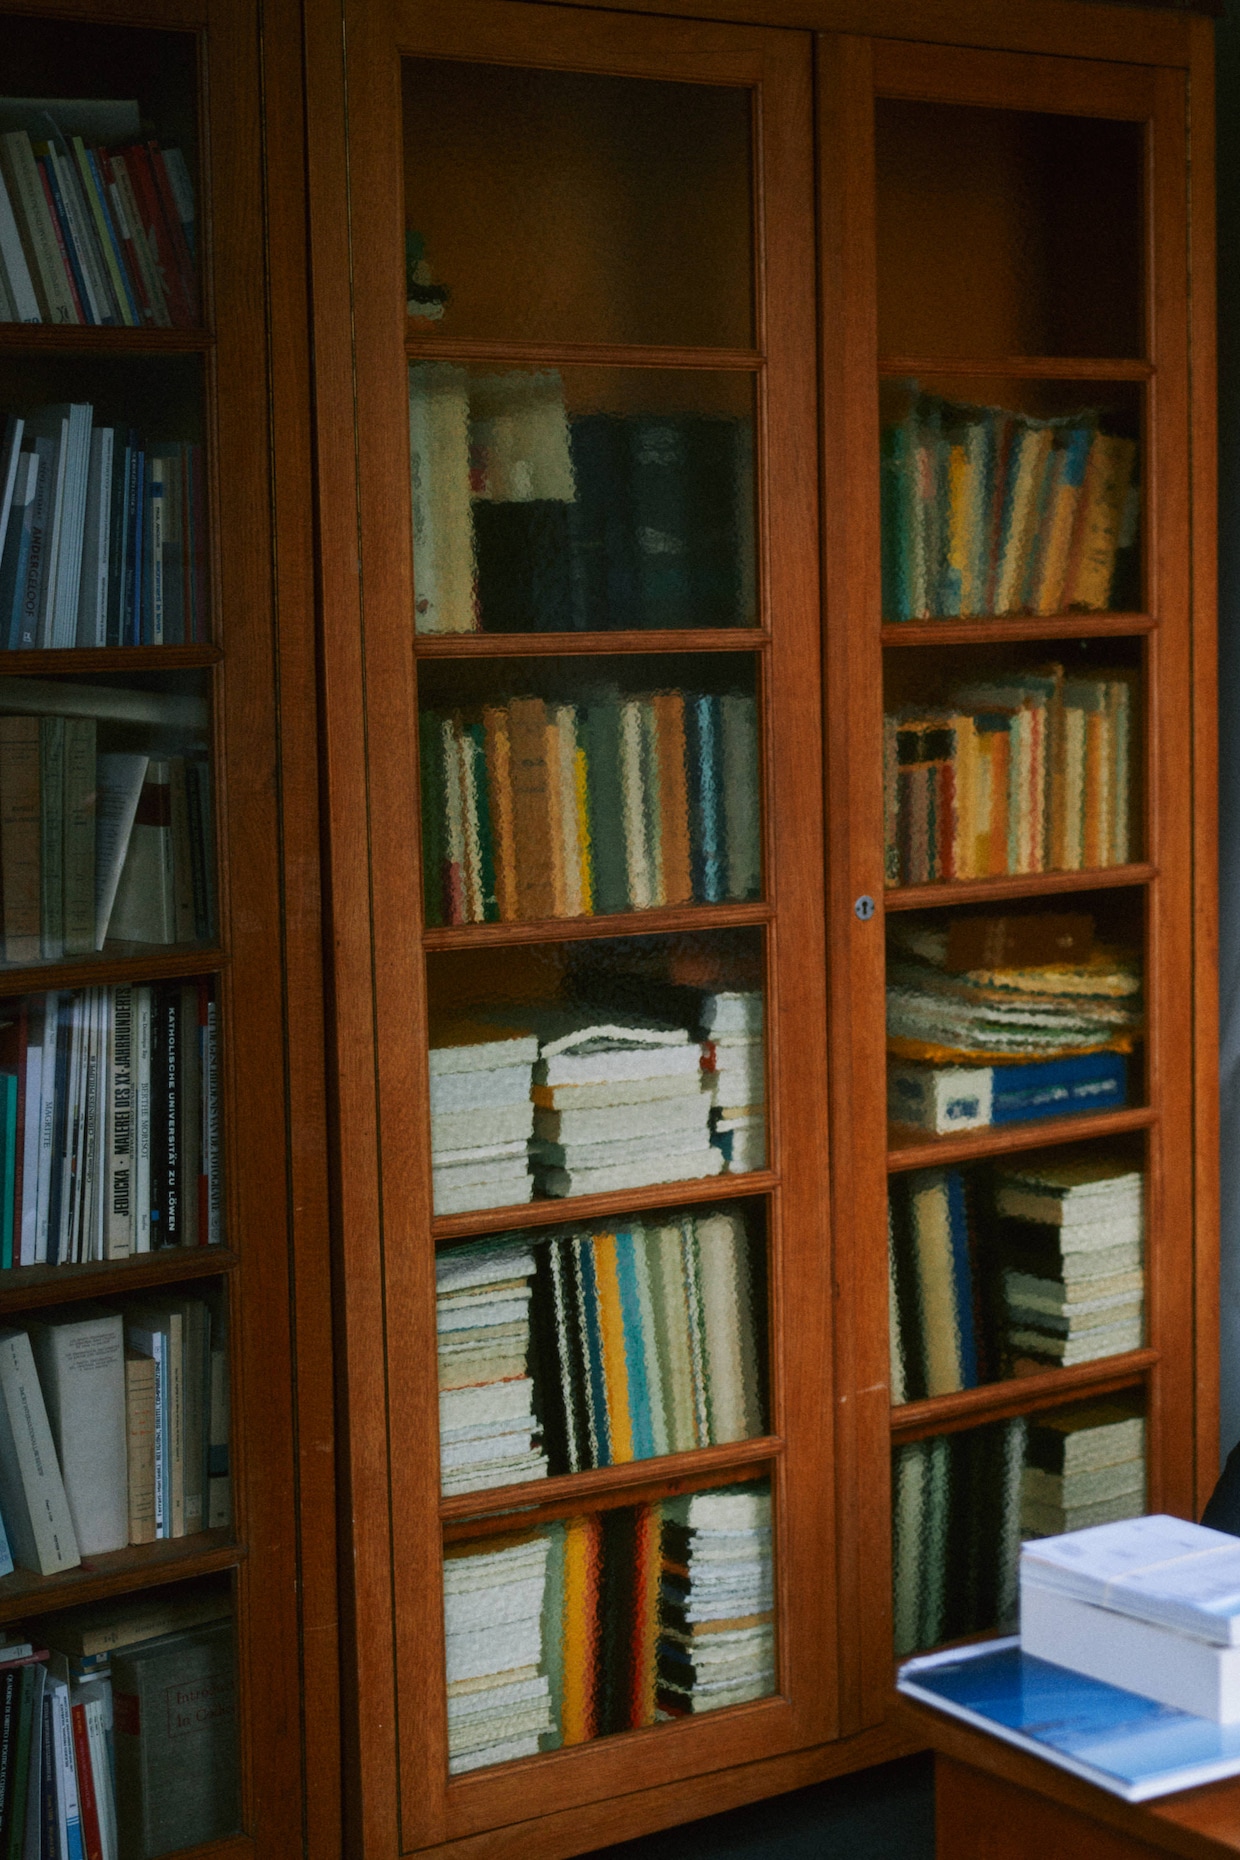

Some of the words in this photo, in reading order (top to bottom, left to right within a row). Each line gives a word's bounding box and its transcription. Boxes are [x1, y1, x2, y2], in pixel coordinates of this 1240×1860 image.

[27, 526, 42, 617] ANDERGELOOF
[115, 987, 132, 1068] JAHRHUNDERTS
[167, 1007, 176, 1089] KATHOLISCHE
[88, 1064, 96, 1095] PHILIPPE
[114, 1088, 131, 1108] DES
[141, 1082, 149, 1117] BERTHE
[43, 1101, 54, 1149] MAGRITTE
[114, 1111, 130, 1155] MALEREI
[141, 1120, 149, 1160] MORISOT
[167, 1092, 178, 1166] UNIVERSITÄT
[113, 1169, 130, 1216] JEDLICKA
[167, 1169, 176, 1186] ZU
[167, 1190, 178, 1231] LÖWEN
[5, 1674, 15, 1705] QUADERNI
[3, 1713, 12, 1738] DIRITTO
